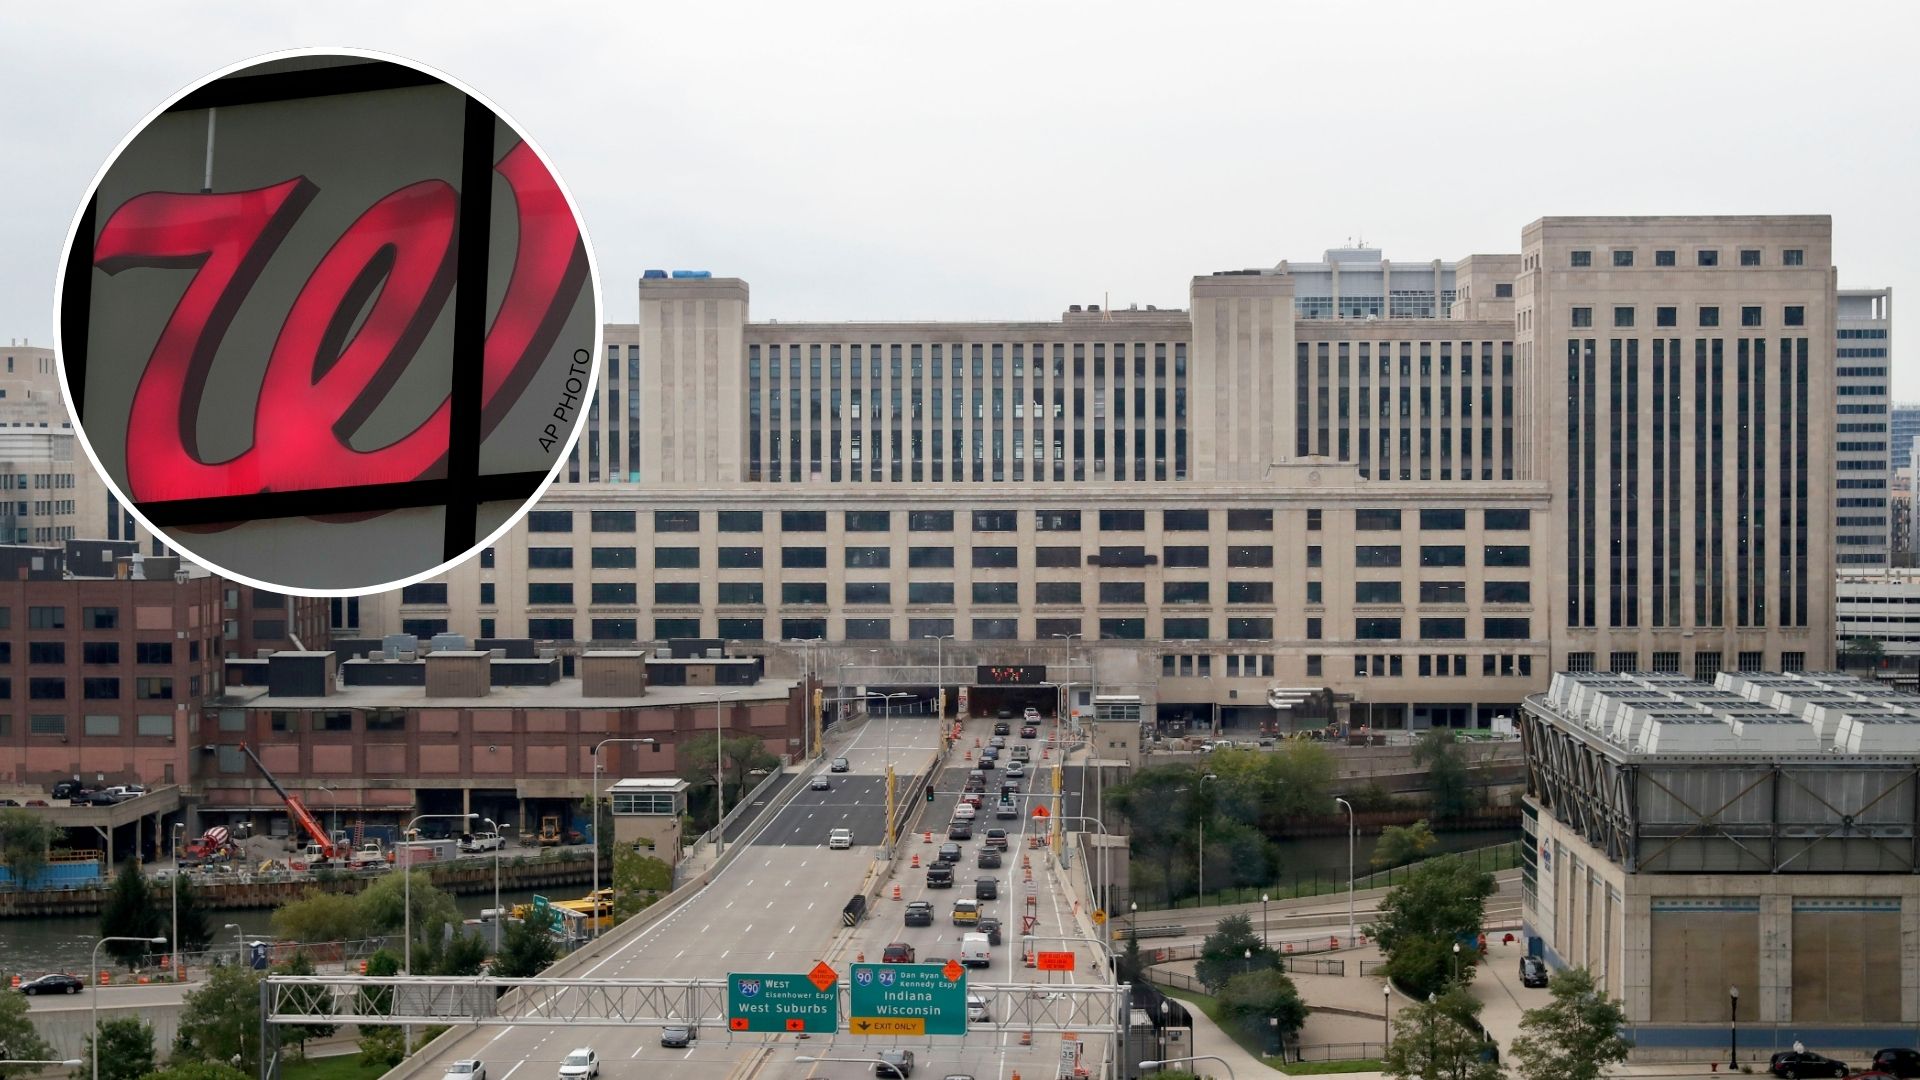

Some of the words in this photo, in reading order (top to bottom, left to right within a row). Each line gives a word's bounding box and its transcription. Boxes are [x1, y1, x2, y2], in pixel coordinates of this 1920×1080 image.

[857, 973, 872, 983] 90
[879, 973, 894, 983] 94
[920, 972, 939, 981] Ryan
[741, 983, 759, 994] 290
[765, 979, 790, 989] WEST
[900, 981, 935, 989] Kennedy
[938, 981, 958, 990] Expy
[765, 991, 812, 999] Eisenhower
[816, 992, 834, 1001] Expy
[884, 991, 932, 1001] Indiana
[738, 1002, 769, 1013] West
[776, 1003, 828, 1014] Suburbs
[876, 1005, 941, 1015] Wisconsin
[1062, 1051, 1074, 1059] 35
